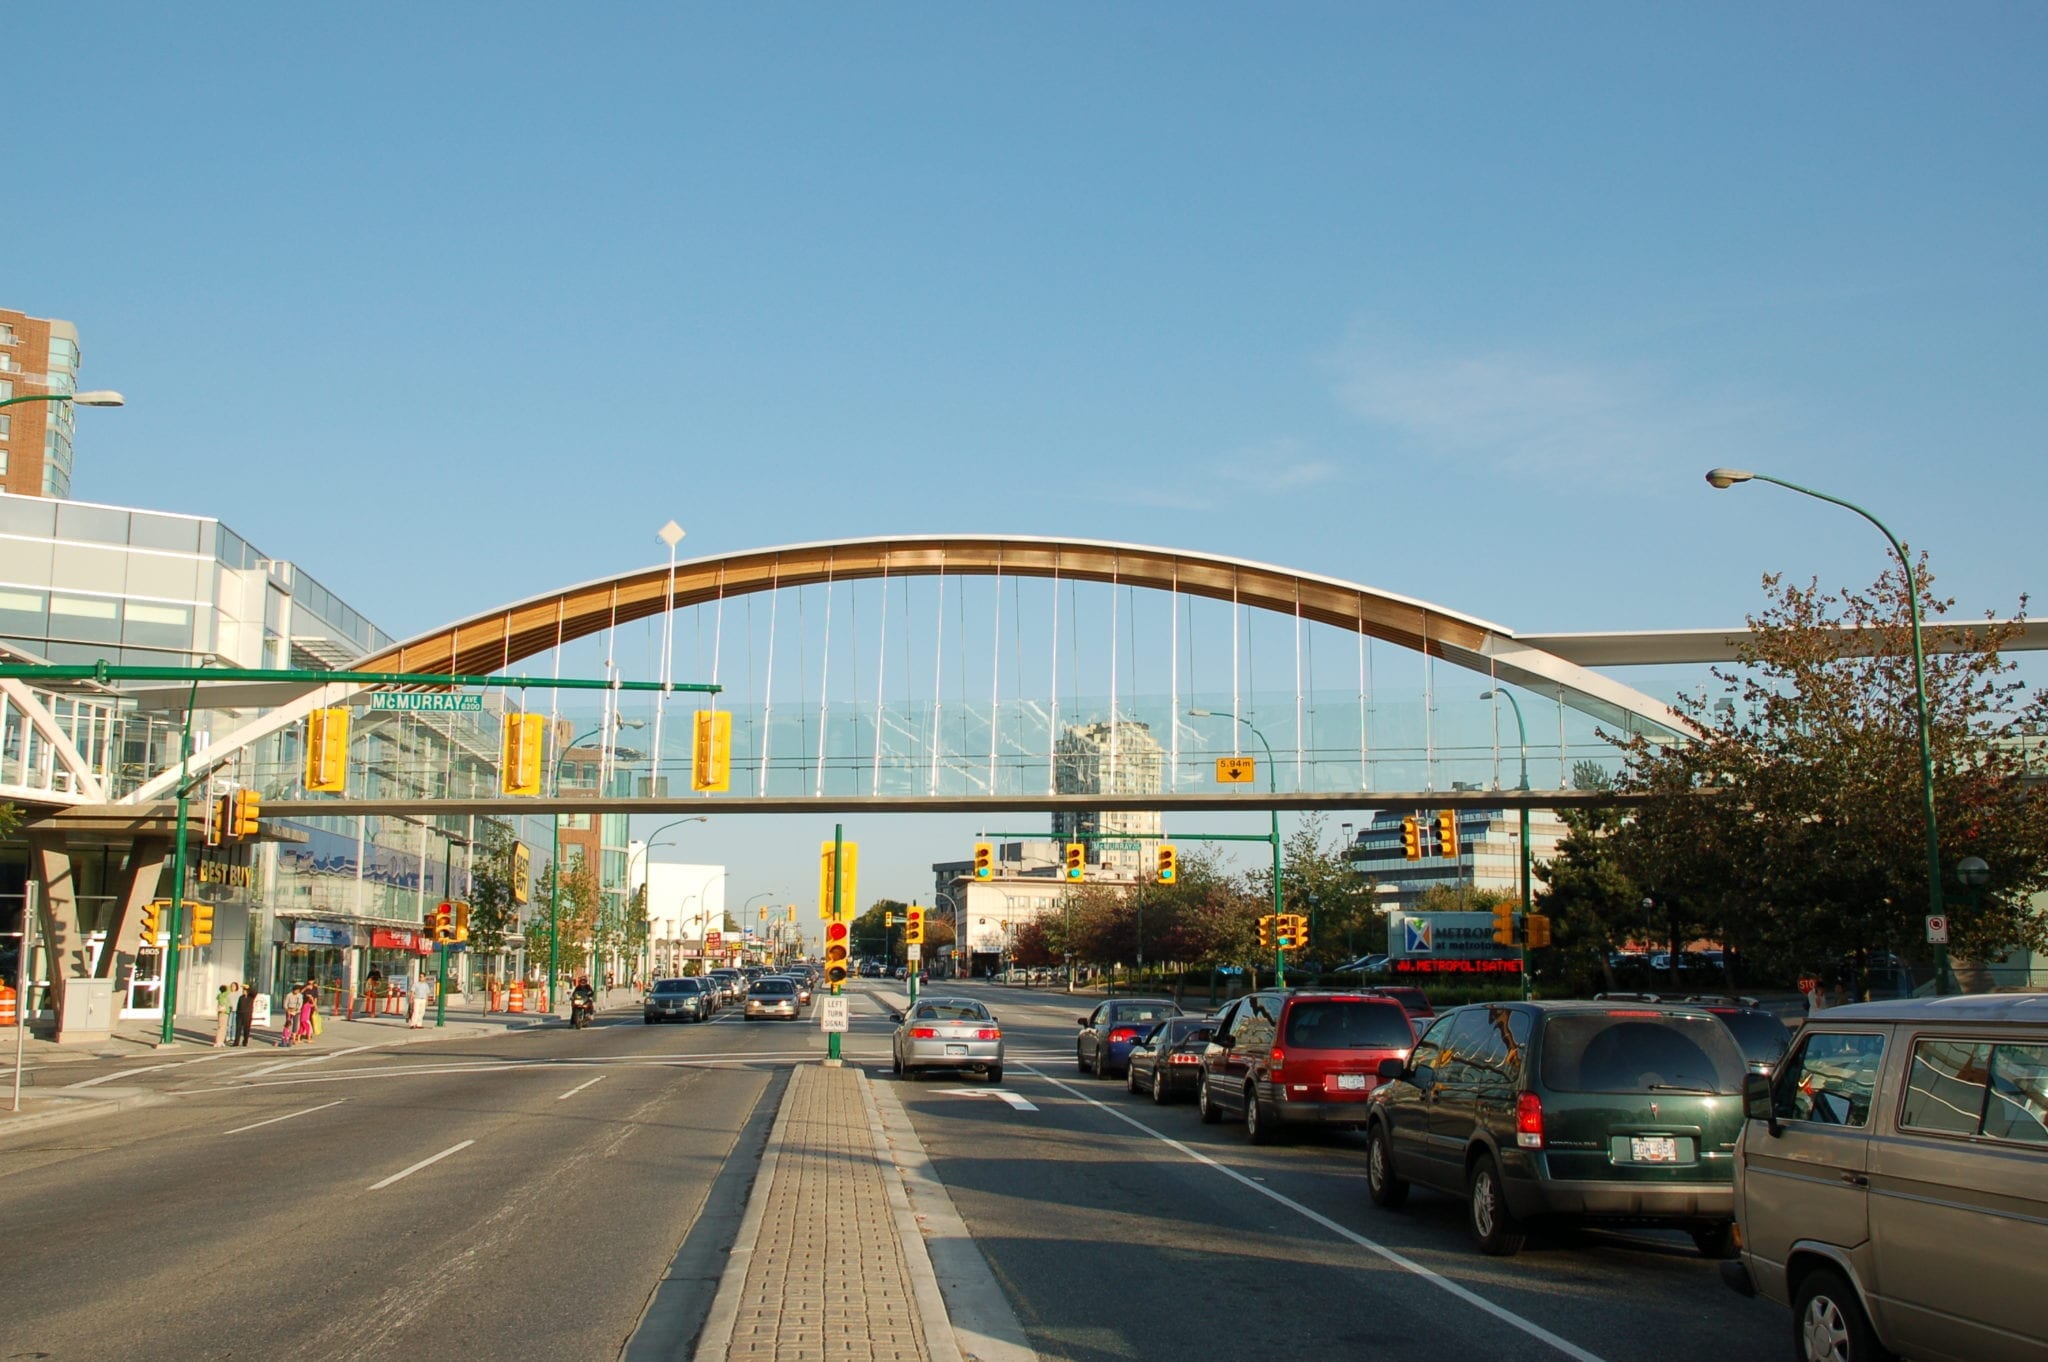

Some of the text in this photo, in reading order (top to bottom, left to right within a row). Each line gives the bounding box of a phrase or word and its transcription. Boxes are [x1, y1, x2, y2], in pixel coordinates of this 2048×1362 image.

[372, 694, 463, 710] McMURRAY
[200, 859, 252, 888] BEST BUY
[1435, 942, 1446, 950] at
[1799, 980, 1815, 990] STO
